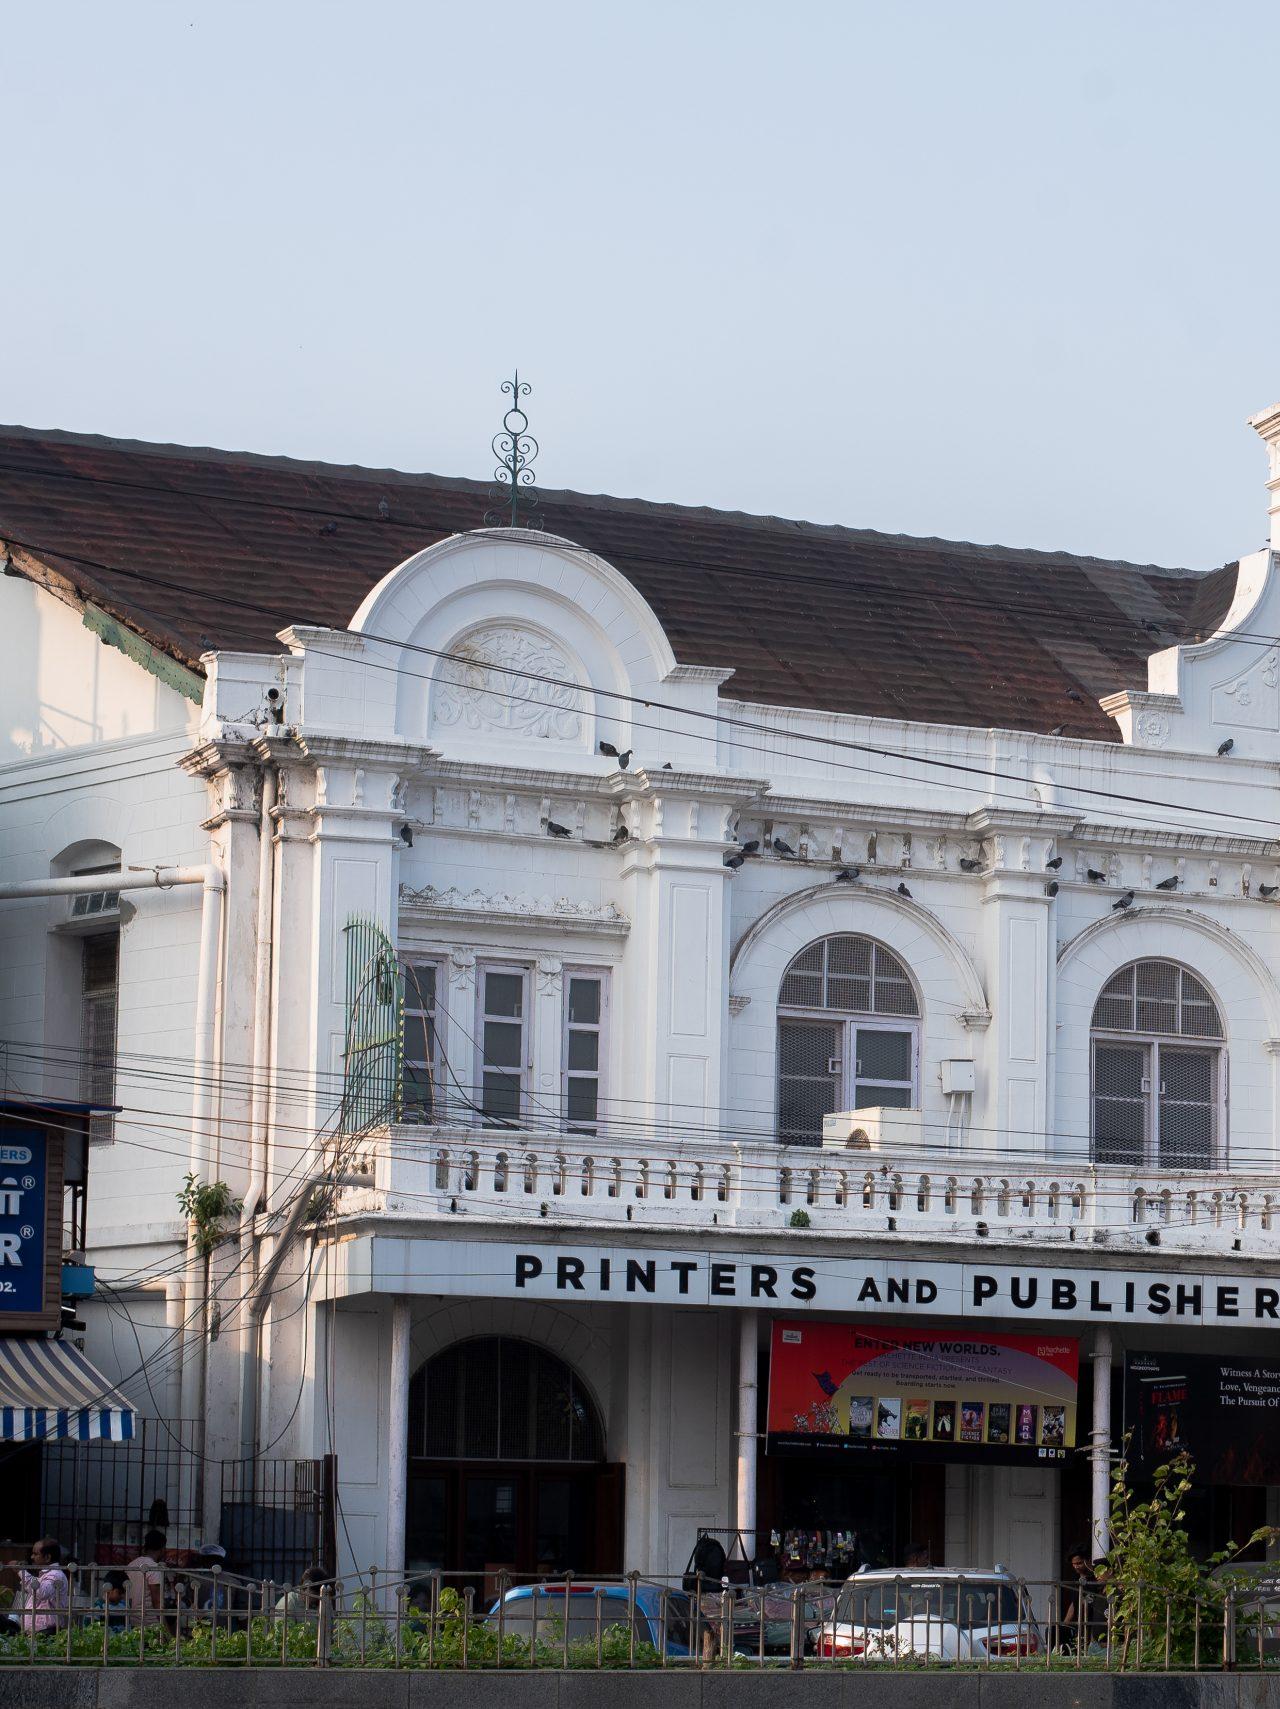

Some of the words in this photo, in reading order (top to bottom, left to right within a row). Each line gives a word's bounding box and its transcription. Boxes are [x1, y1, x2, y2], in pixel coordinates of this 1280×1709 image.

[514, 1254, 817, 1303] PRINTERS
[856, 1276, 938, 1305] AND
[854, 1337, 899, 1351] ENTER
[903, 1340, 934, 1353] NEW
[939, 1342, 1001, 1357] WORLDS.
[1220, 1367, 1252, 1377] Witness
[1254, 1369, 1261, 1378] A
[1220, 1381, 1241, 1392] Love,
[1220, 1395, 1236, 1405] The
[1238, 1396, 1266, 1406] Pursuit
[1267, 1396, 1280, 1407] Of
